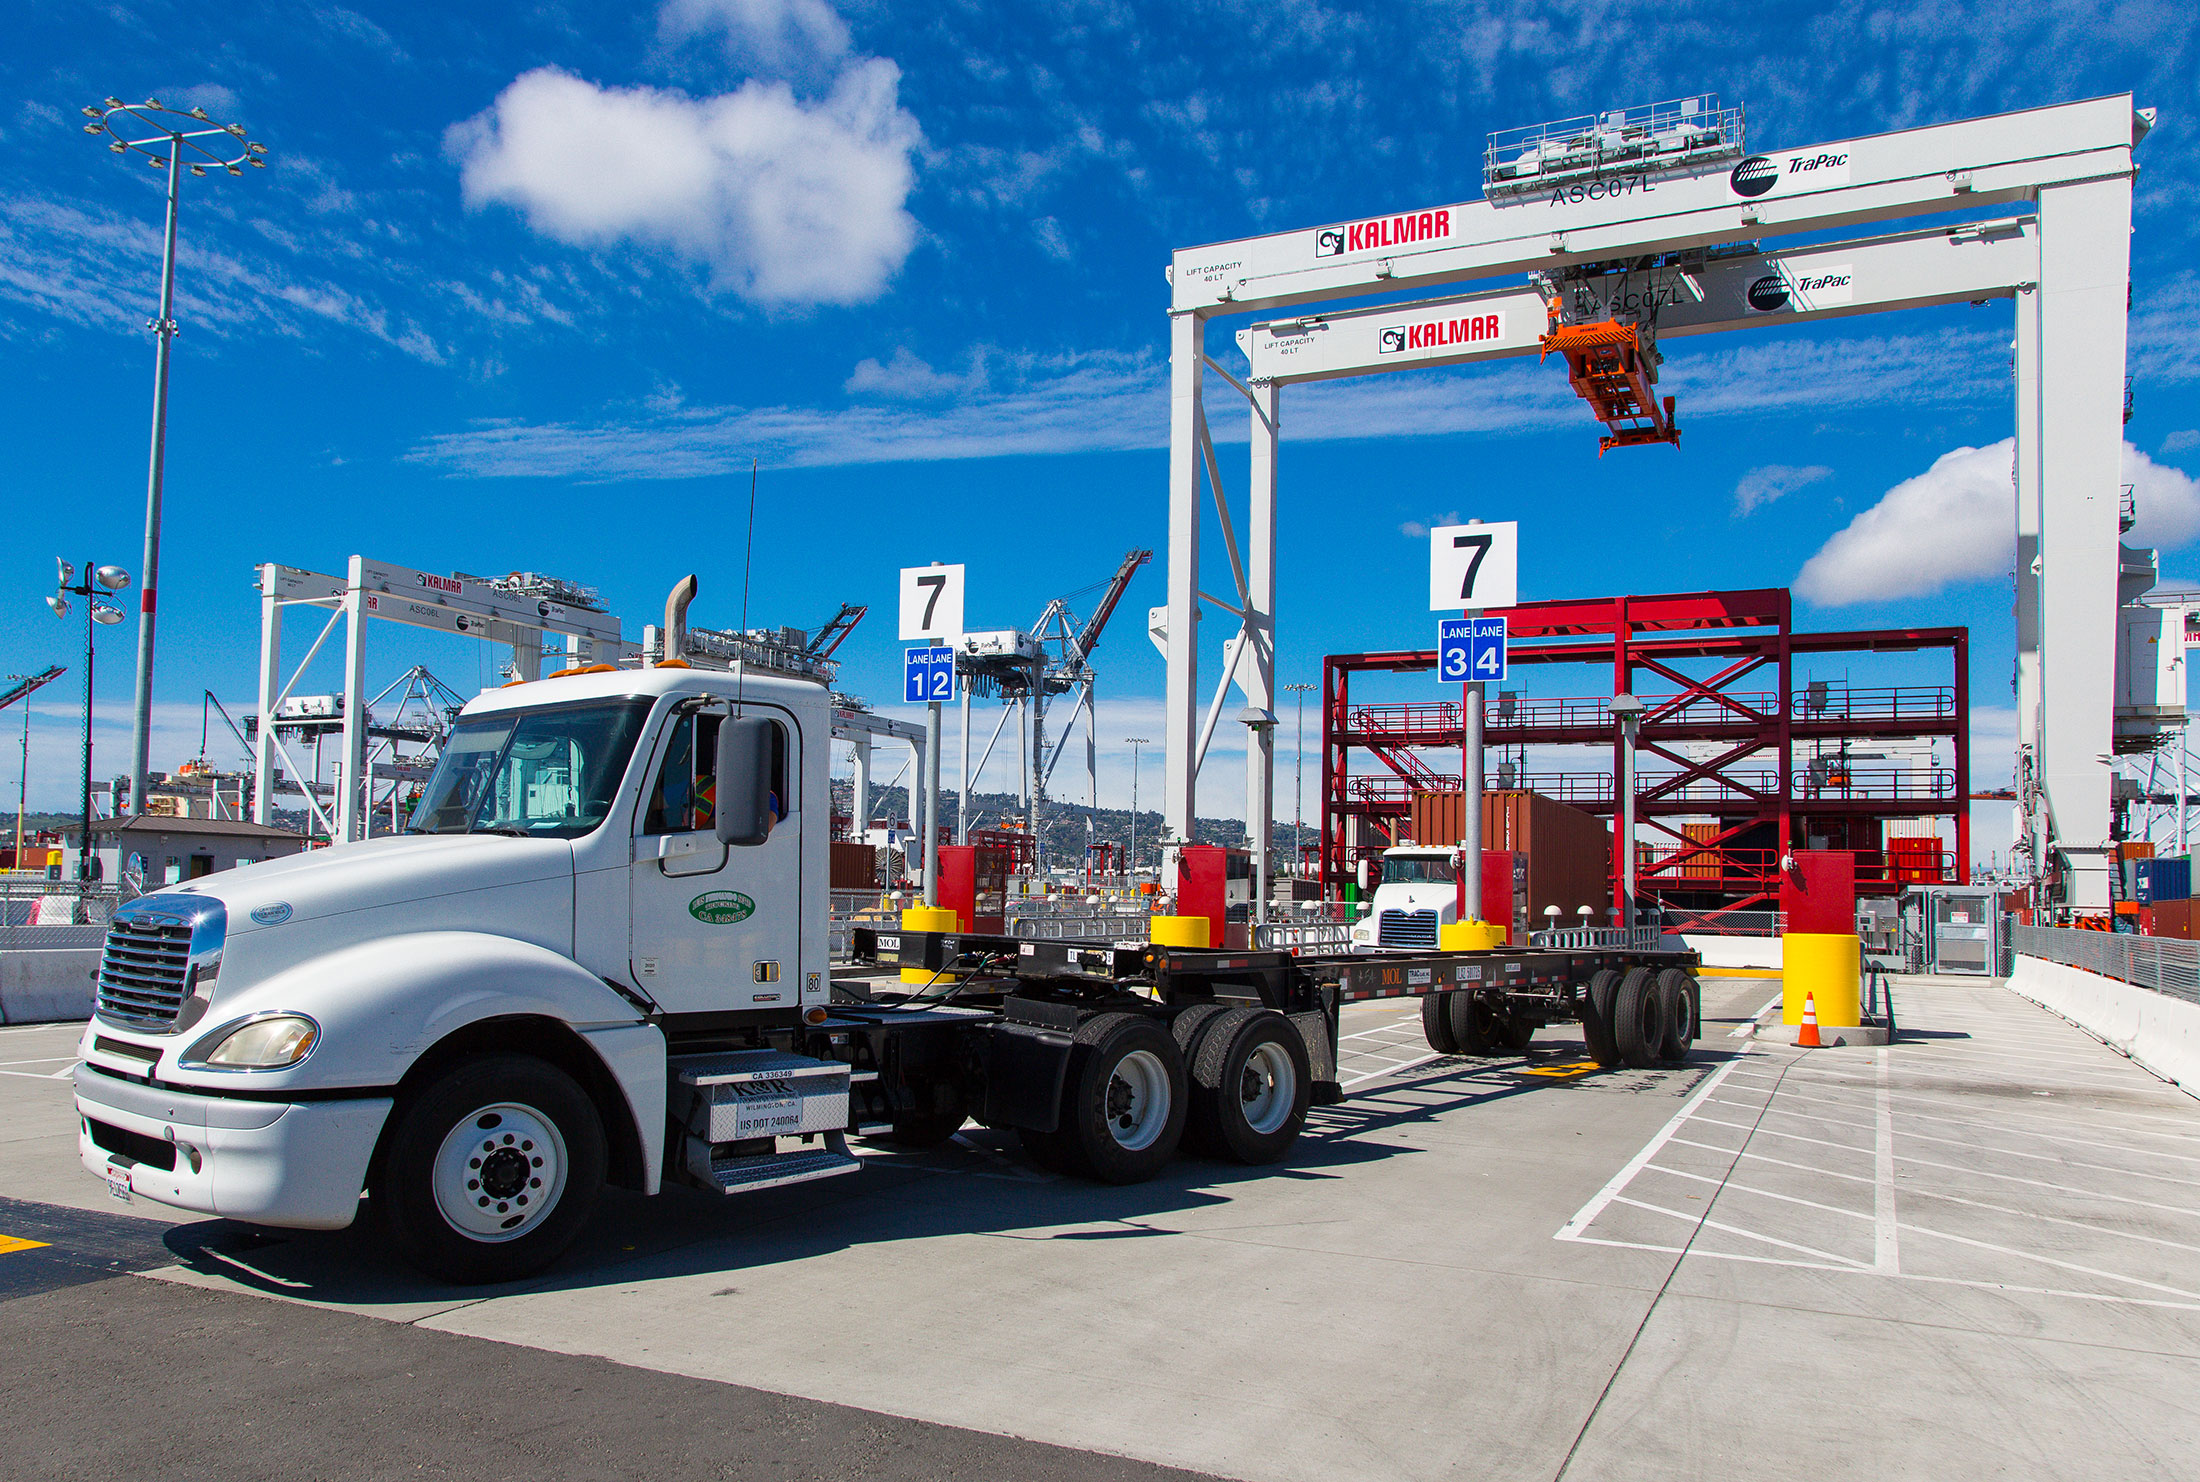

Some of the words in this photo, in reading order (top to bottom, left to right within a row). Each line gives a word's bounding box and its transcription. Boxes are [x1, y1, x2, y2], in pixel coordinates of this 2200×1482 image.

[1788, 152, 1849, 175] TraPac
[1550, 175, 1656, 208] ASC07L
[1348, 210, 1450, 251] KALMAR
[1186, 267, 1203, 276] LIFT
[1204, 262, 1243, 275] CAPACITY
[1204, 274, 1214, 282] 40
[1214, 273, 1224, 282] LT
[1798, 274, 1852, 292] TraPac
[1408, 314, 1500, 350] KALMAR
[1264, 340, 1280, 350] LIFT
[1280, 336, 1316, 348] CAPACITY
[1453, 534, 1493, 600] 7
[427, 574, 462, 594] KALMAR
[917, 574, 946, 630] 7
[409, 604, 440, 618] ASC06L
[1442, 626, 1471, 638] LANE
[1474, 624, 1503, 638] LANE
[907, 654, 929, 665] LANE
[930, 653, 952, 664] LANE
[1445, 648, 1468, 676] 3
[1476, 646, 1500, 675] 4
[912, 672, 924, 697] 1
[932, 671, 949, 696] 2
[890, 812, 896, 826] 6
[879, 938, 900, 948] MOL
[808, 978, 819, 990] 80
[1382, 968, 1402, 985] MOL
[766, 1070, 793, 1079] 336349
[740, 1119, 752, 1130] US
[754, 1118, 770, 1128] DOT
[770, 1115, 799, 1128] 240064
